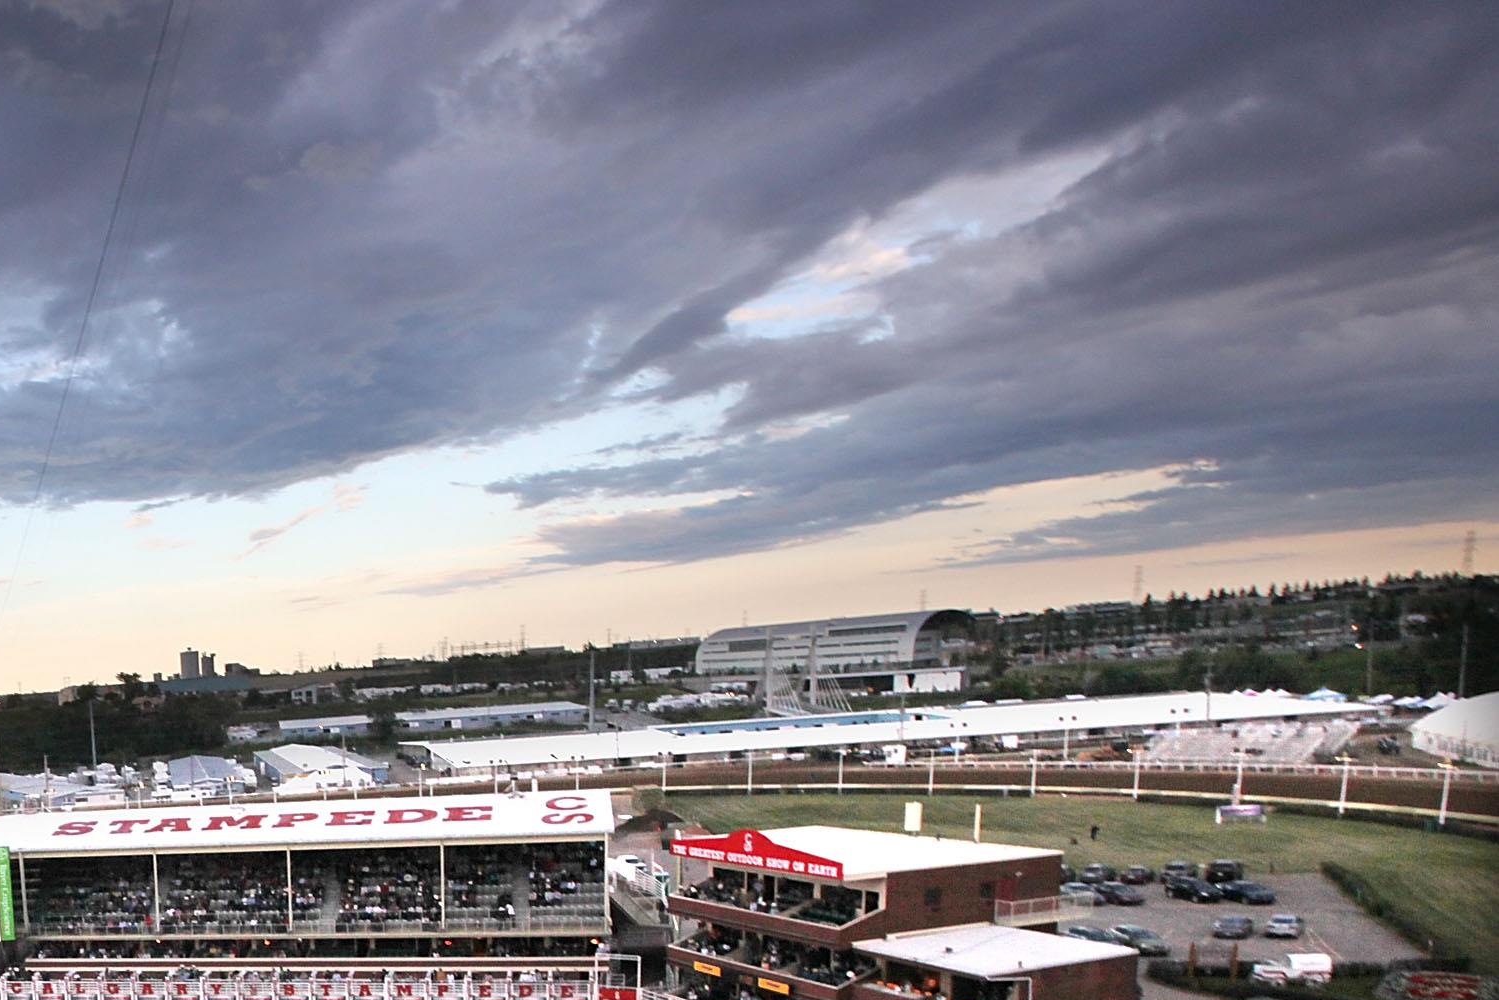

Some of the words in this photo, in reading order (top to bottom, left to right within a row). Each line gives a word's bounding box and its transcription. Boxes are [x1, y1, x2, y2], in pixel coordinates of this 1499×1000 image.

[52, 806, 493, 836] STAMPEDE
[672, 844, 687, 855] THE
[688, 846, 725, 861] GREATEST
[726, 852, 764, 866] OUTDOOR
[765, 857, 790, 870] SHOW
[792, 860, 805, 872] ON
[807, 863, 838, 877] EARTH
